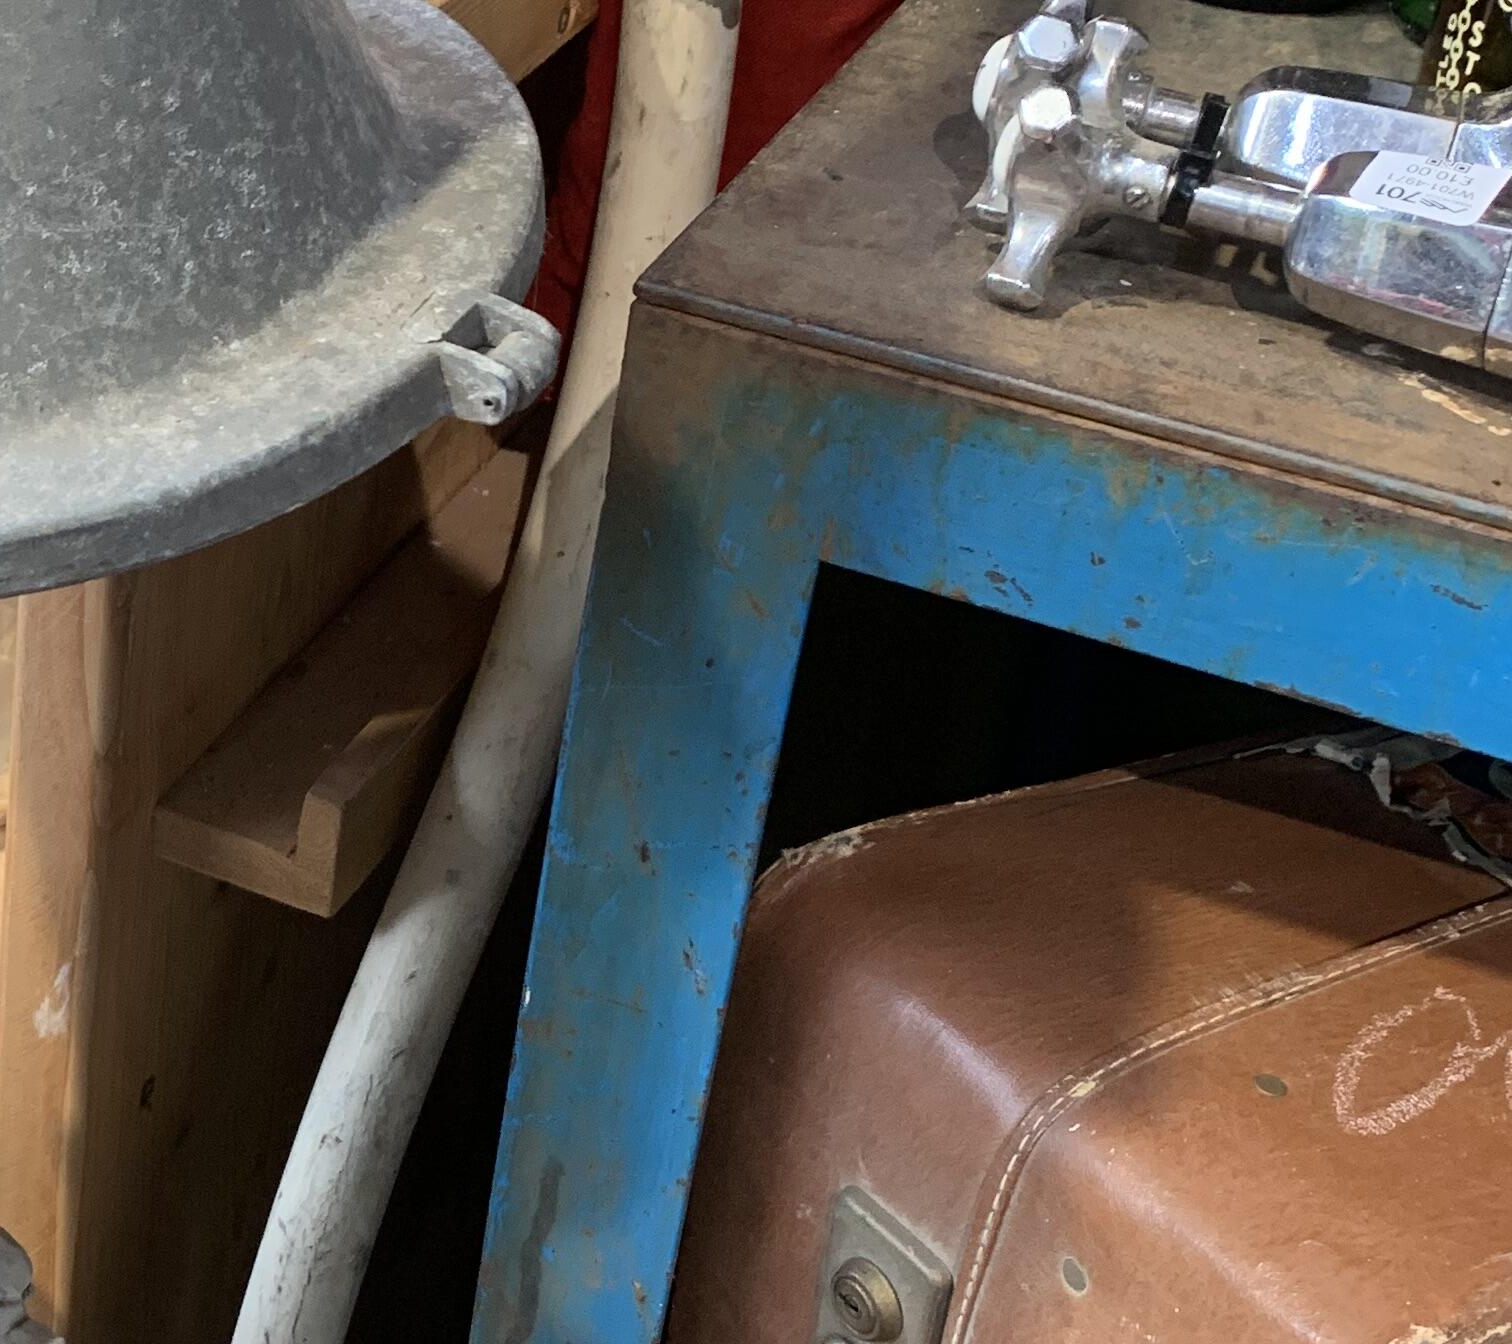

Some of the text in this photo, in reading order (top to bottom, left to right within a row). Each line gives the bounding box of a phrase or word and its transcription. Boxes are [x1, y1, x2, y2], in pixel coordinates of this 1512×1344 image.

[1387, 172, 1475, 200] W701-4971
[1406, 163, 1474, 186] £10.00
[1376, 183, 1422, 204] 701
